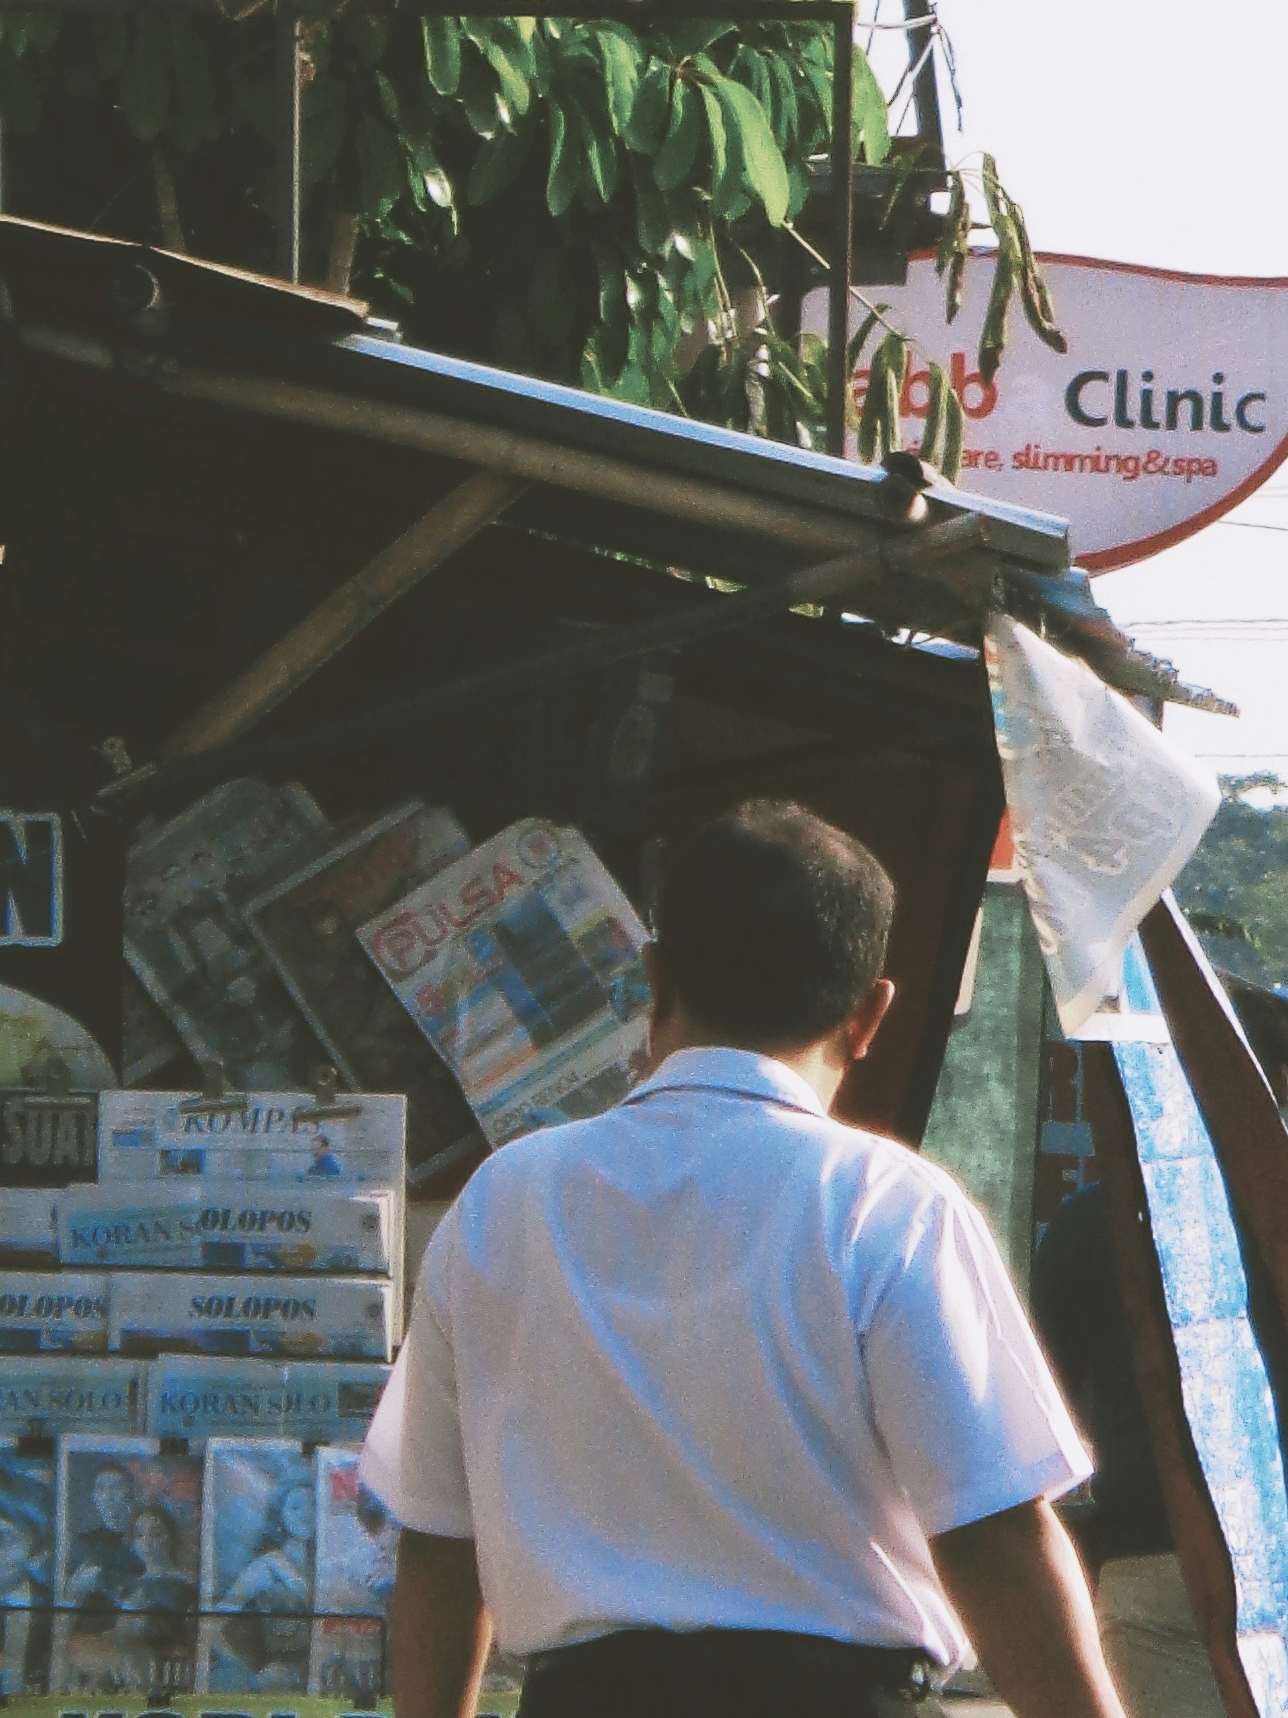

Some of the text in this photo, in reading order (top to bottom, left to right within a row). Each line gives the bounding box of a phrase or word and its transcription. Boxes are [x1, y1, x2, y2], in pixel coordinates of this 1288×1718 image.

[1065, 367, 1267, 433] Clinic
[380, 853, 529, 969] PULSA
[190, 1292, 317, 1320] SOLOPOS
[161, 1390, 260, 1416] KORAN
